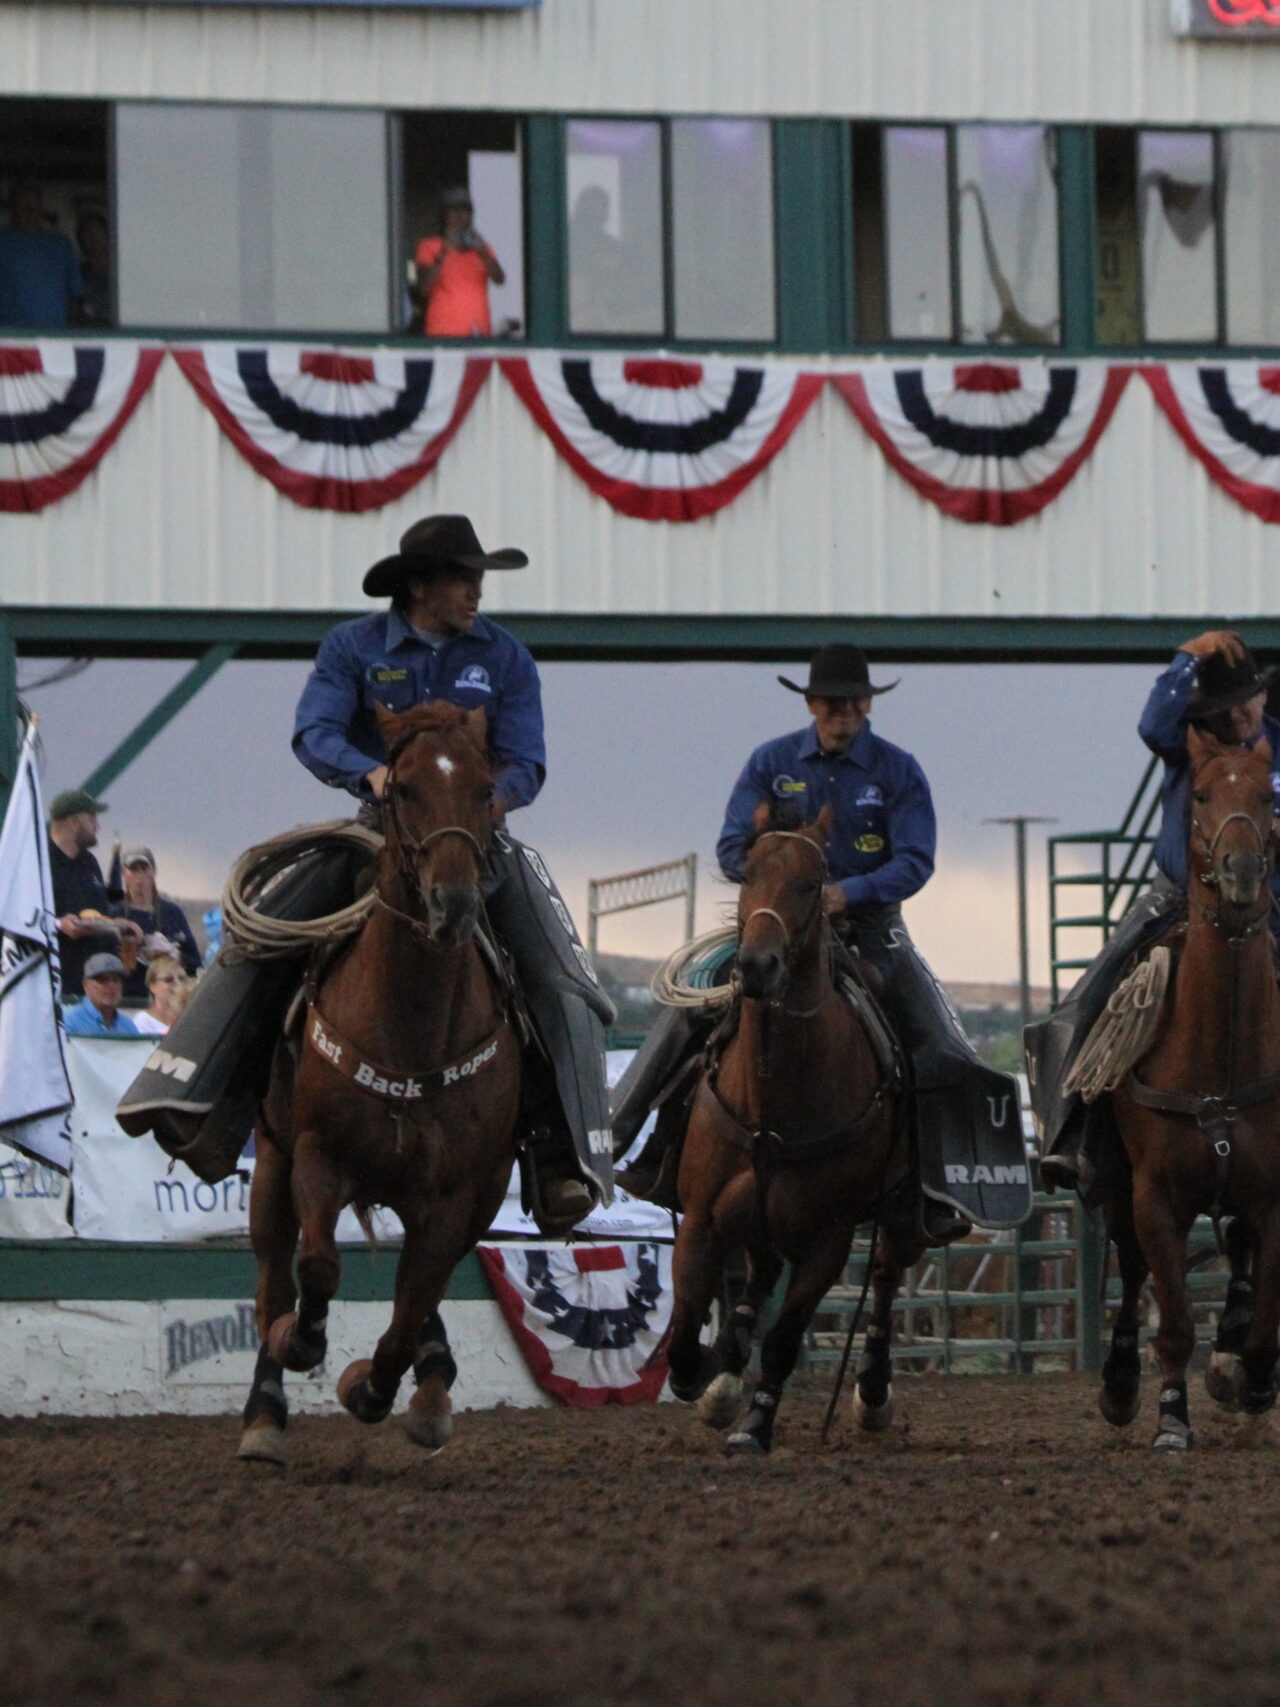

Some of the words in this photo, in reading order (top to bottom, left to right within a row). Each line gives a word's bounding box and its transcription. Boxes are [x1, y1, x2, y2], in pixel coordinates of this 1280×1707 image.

[311, 1020, 343, 1065] Fast
[353, 1062, 422, 1098] Back
[442, 1040, 498, 1086] Ropes
[944, 1164, 1027, 1185] RAM
